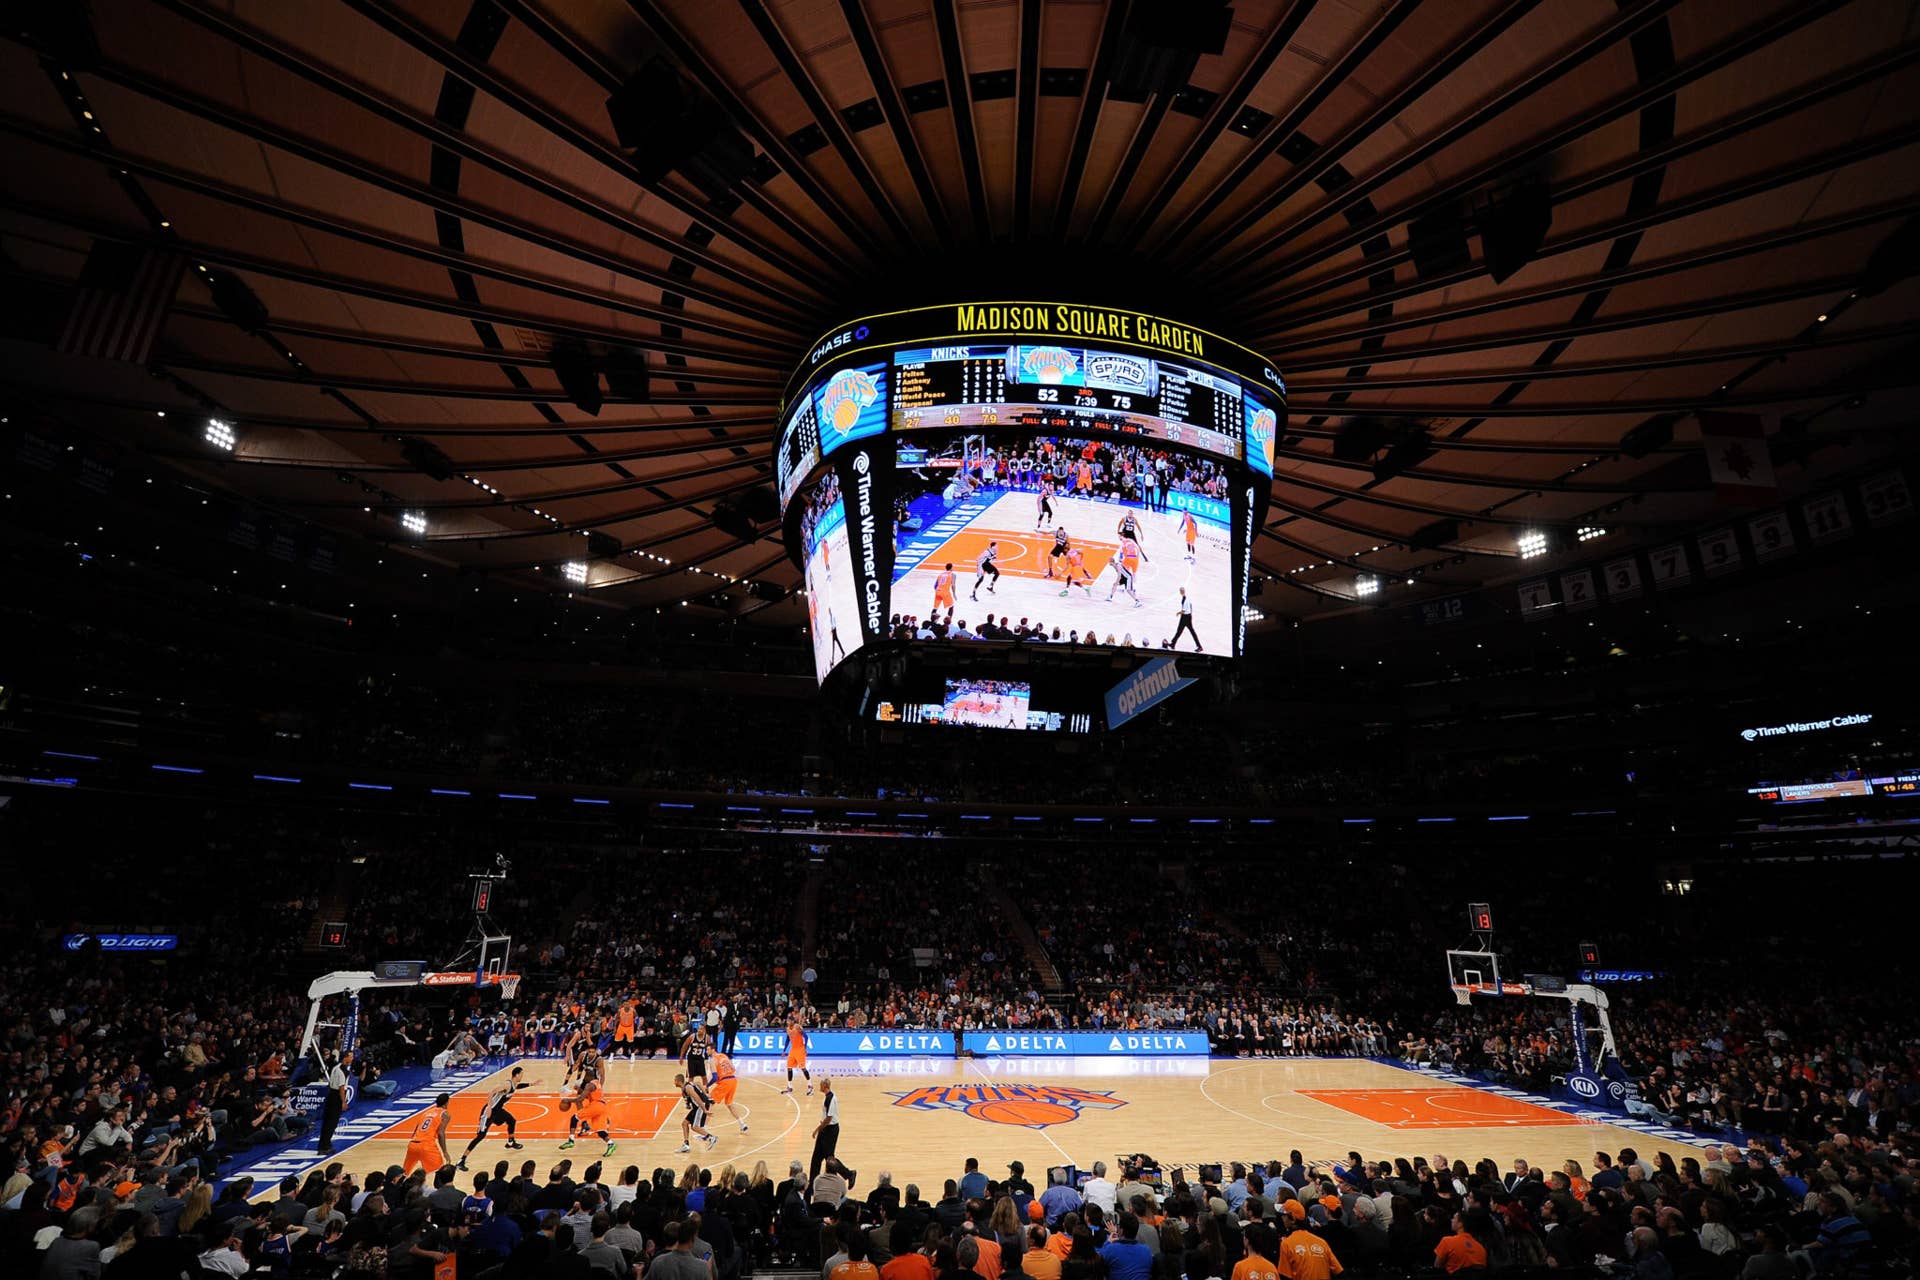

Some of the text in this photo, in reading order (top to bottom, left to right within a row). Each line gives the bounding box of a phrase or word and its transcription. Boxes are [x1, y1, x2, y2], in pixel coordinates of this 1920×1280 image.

[957, 305, 1204, 356] MADISON SQUARE GARDEN
[811, 331, 852, 364] CHASE
[931, 347, 969, 360] KNICKS
[1095, 363, 1140, 379] SPURS
[824, 373, 878, 422] KNICKS
[1038, 389, 1131, 408] 52 7:39 75
[1166, 391, 1185, 400] Green
[1166, 405, 1189, 416] Duncan
[906, 414, 997, 428] 27 40 79
[1168, 431, 1179, 440] 50
[1199, 438, 1210, 448] 64
[1178, 495, 1220, 516] DELTA
[1871, 482, 1906, 515] 35
[858, 472, 882, 629] Time Warner Cable
[1662, 556, 1676, 578] 7
[1616, 570, 1630, 588] 3
[1572, 582, 1586, 601] 2
[1756, 714, 1868, 737] Time Warner Cable
[1478, 913, 1490, 928] 13
[117, 938, 172, 947] LIGHT
[329, 932, 340, 944] 13
[880, 1036, 942, 1050] DELTA
[1006, 1036, 1067, 1050] DELTA
[1128, 1036, 1186, 1050] DELTA
[393, 1071, 490, 1104] KNICKS
[1574, 1079, 1595, 1095] KIA
[892, 1086, 1129, 1107] KNICKS
[421, 1118, 431, 1130] 8
